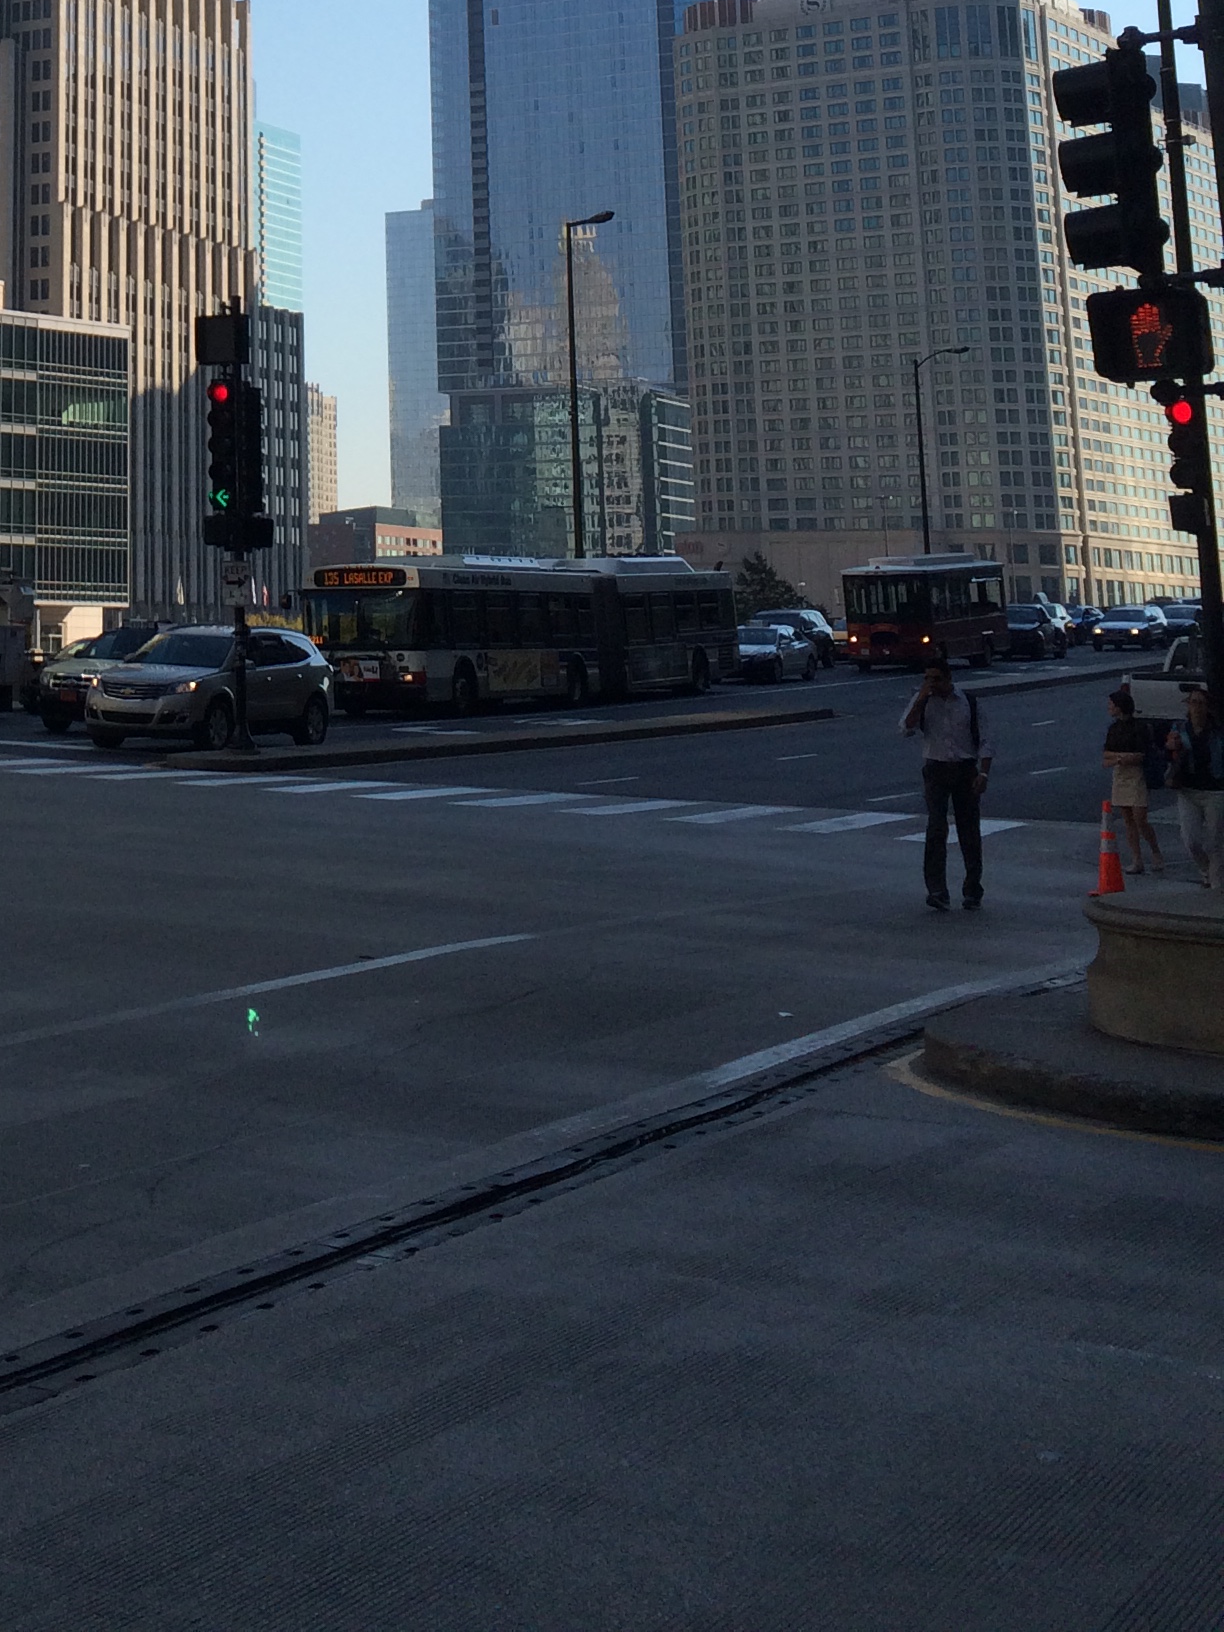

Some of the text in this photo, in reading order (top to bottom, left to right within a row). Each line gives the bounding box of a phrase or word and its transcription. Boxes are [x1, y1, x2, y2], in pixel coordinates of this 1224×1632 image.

[224, 565, 247, 575] KEEP
[323, 571, 394, 586] 135 LASALLE EXP
